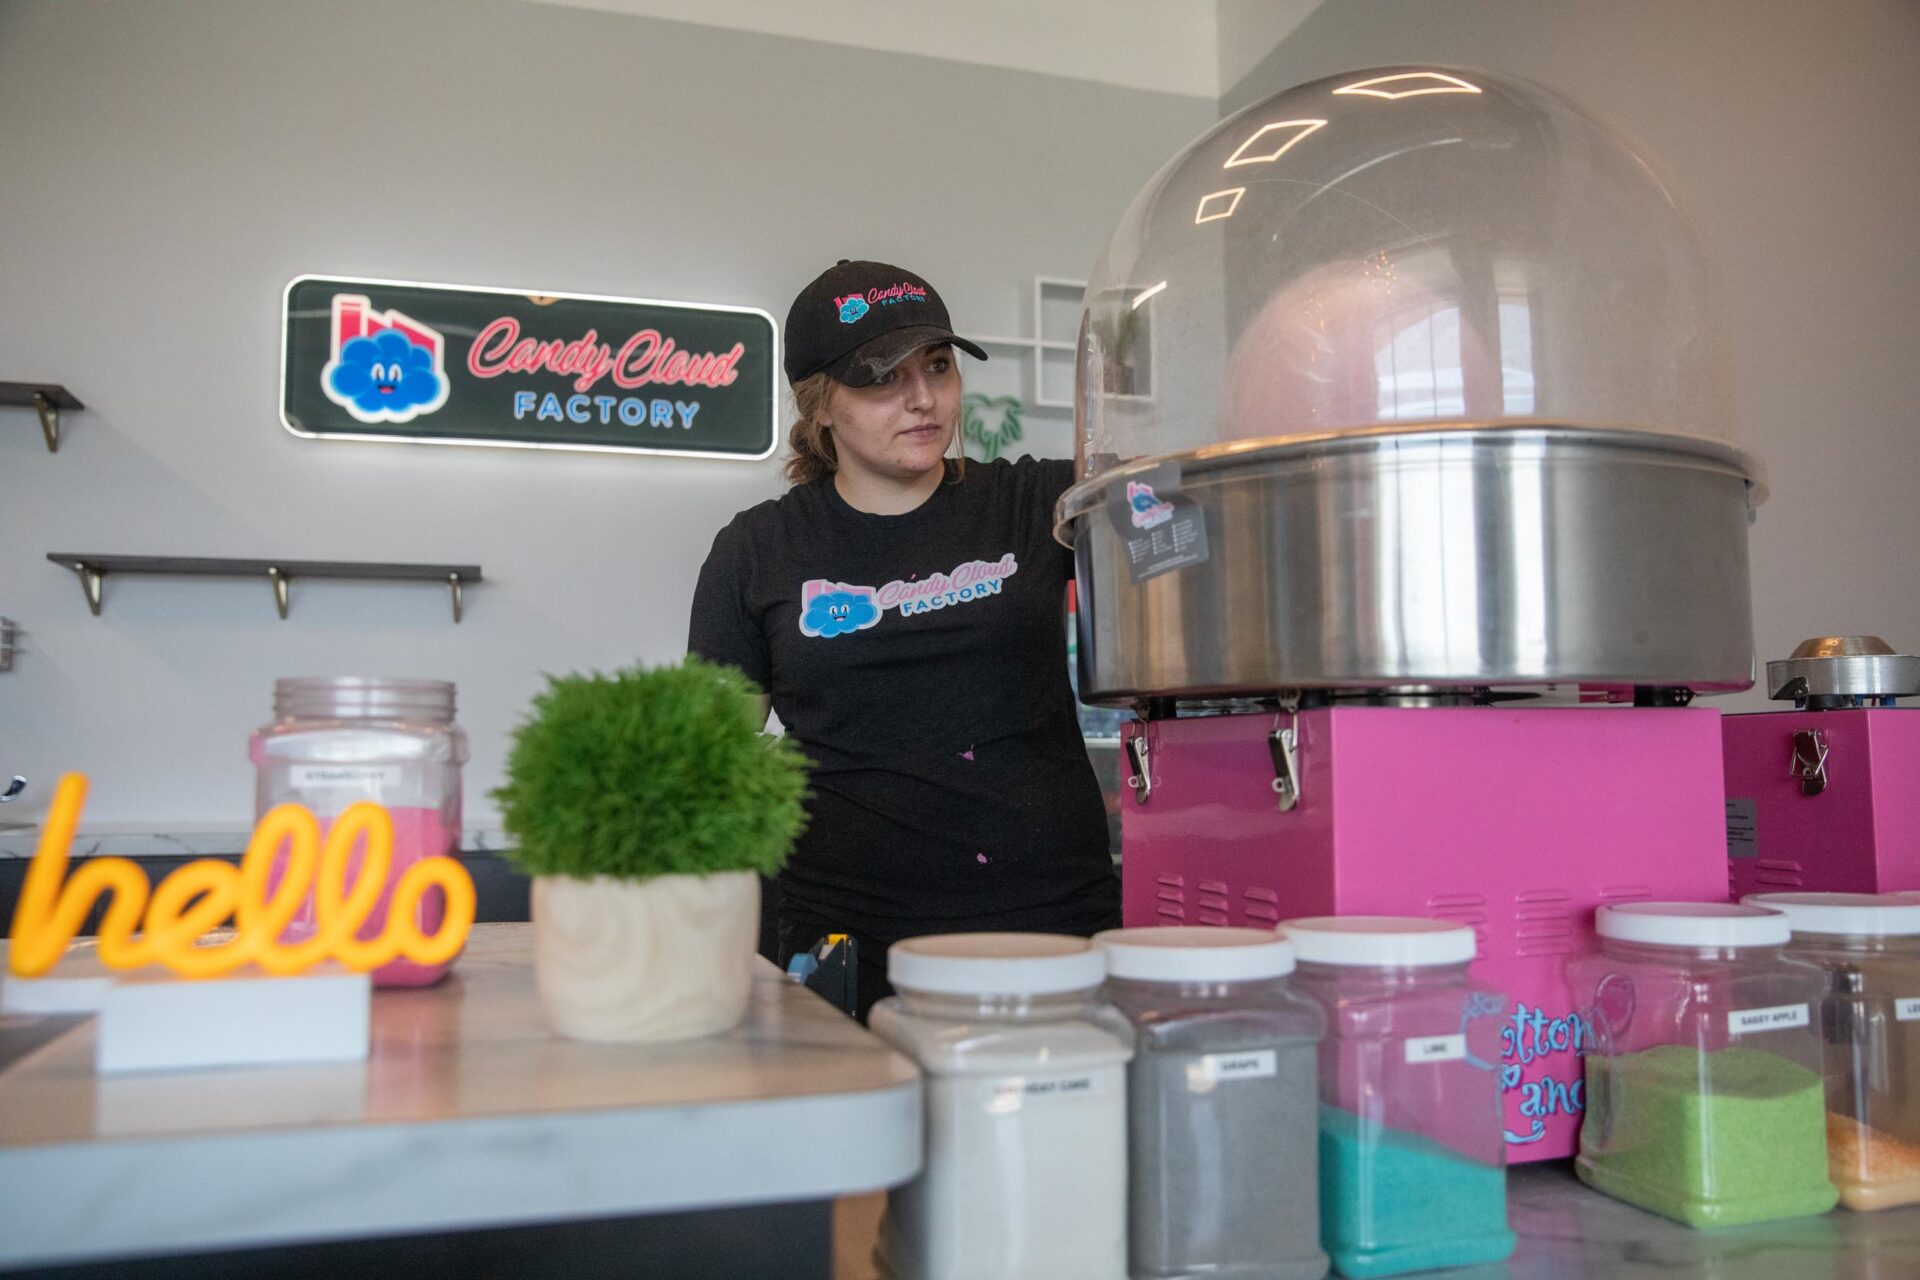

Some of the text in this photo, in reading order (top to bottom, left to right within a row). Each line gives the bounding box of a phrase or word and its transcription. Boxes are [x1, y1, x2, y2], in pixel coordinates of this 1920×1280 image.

[867, 283, 904, 304] Candy
[467, 316, 744, 392] Candy Cloud
[513, 391, 701, 429] FACTORY
[878, 556, 1015, 607] Candy Cloud
[902, 578, 1000, 615] FACTORY
[8, 770, 477, 978] hello
[1771, 1010, 1798, 1023] APPLE
